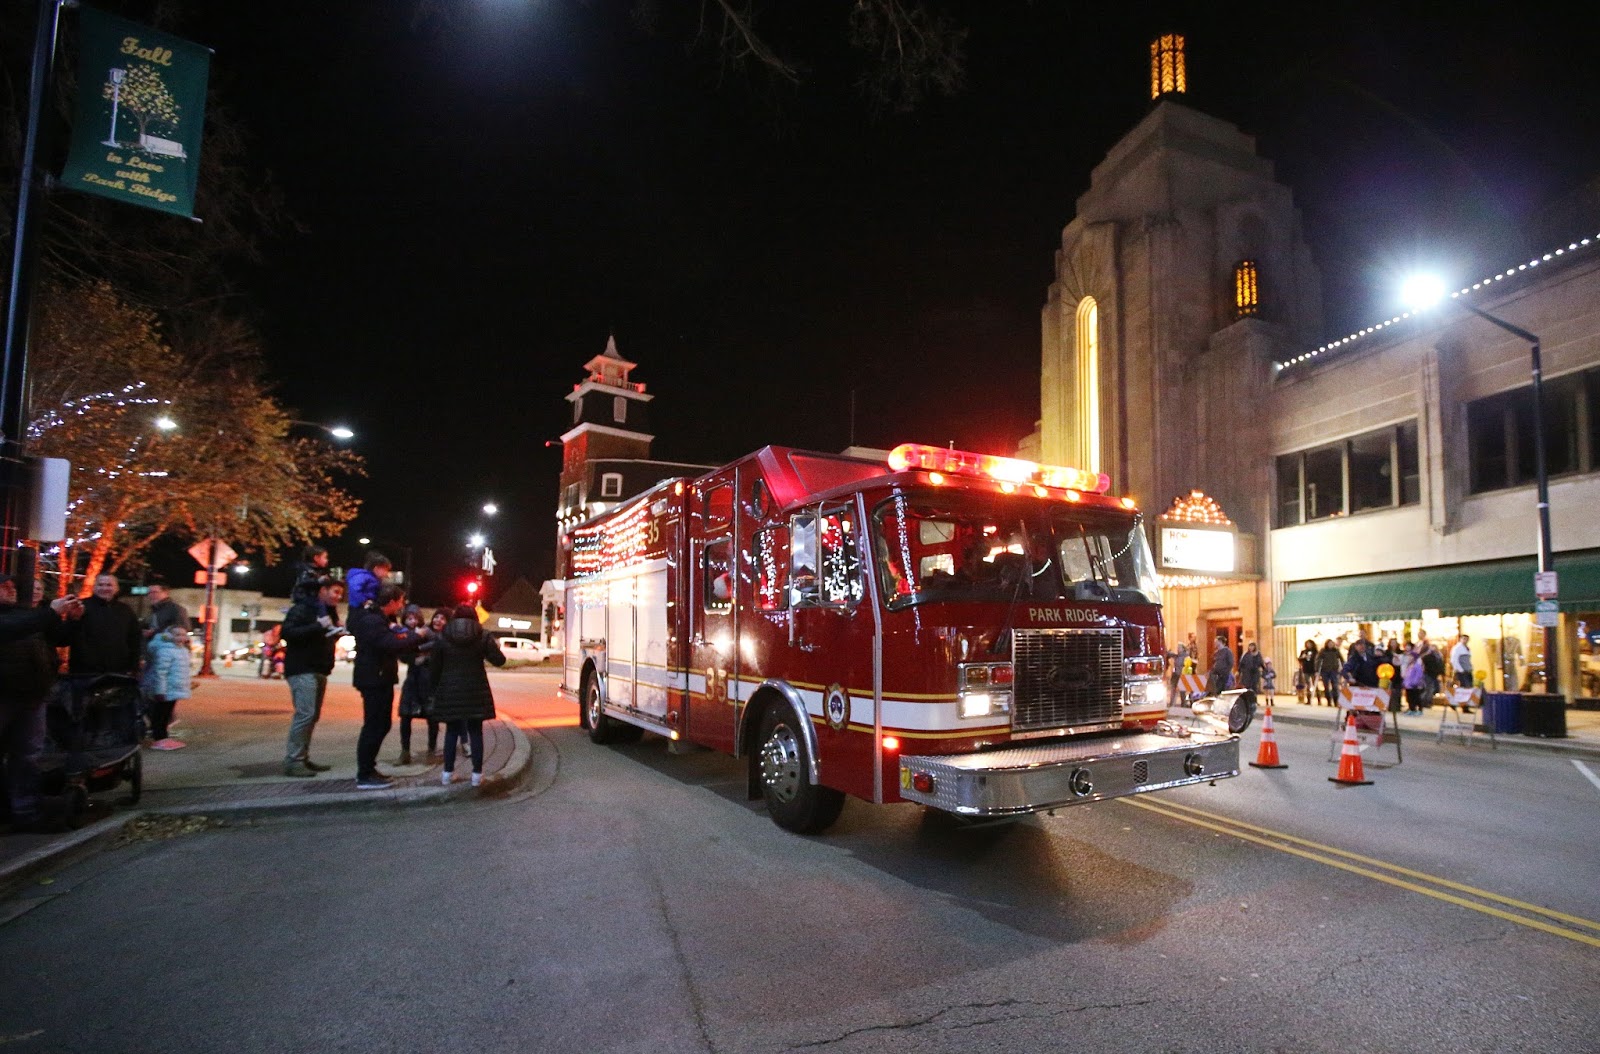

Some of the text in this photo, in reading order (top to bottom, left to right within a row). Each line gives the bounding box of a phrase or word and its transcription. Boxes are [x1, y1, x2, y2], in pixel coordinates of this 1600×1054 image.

[120, 37, 173, 66] Fall
[115, 170, 150, 183] with
[125, 156, 164, 173] Love
[82, 173, 177, 202] Park Ridge
[647, 519, 660, 545] 35
[1029, 608, 1100, 622] PARK RIDGE
[706, 667, 727, 701] 35
